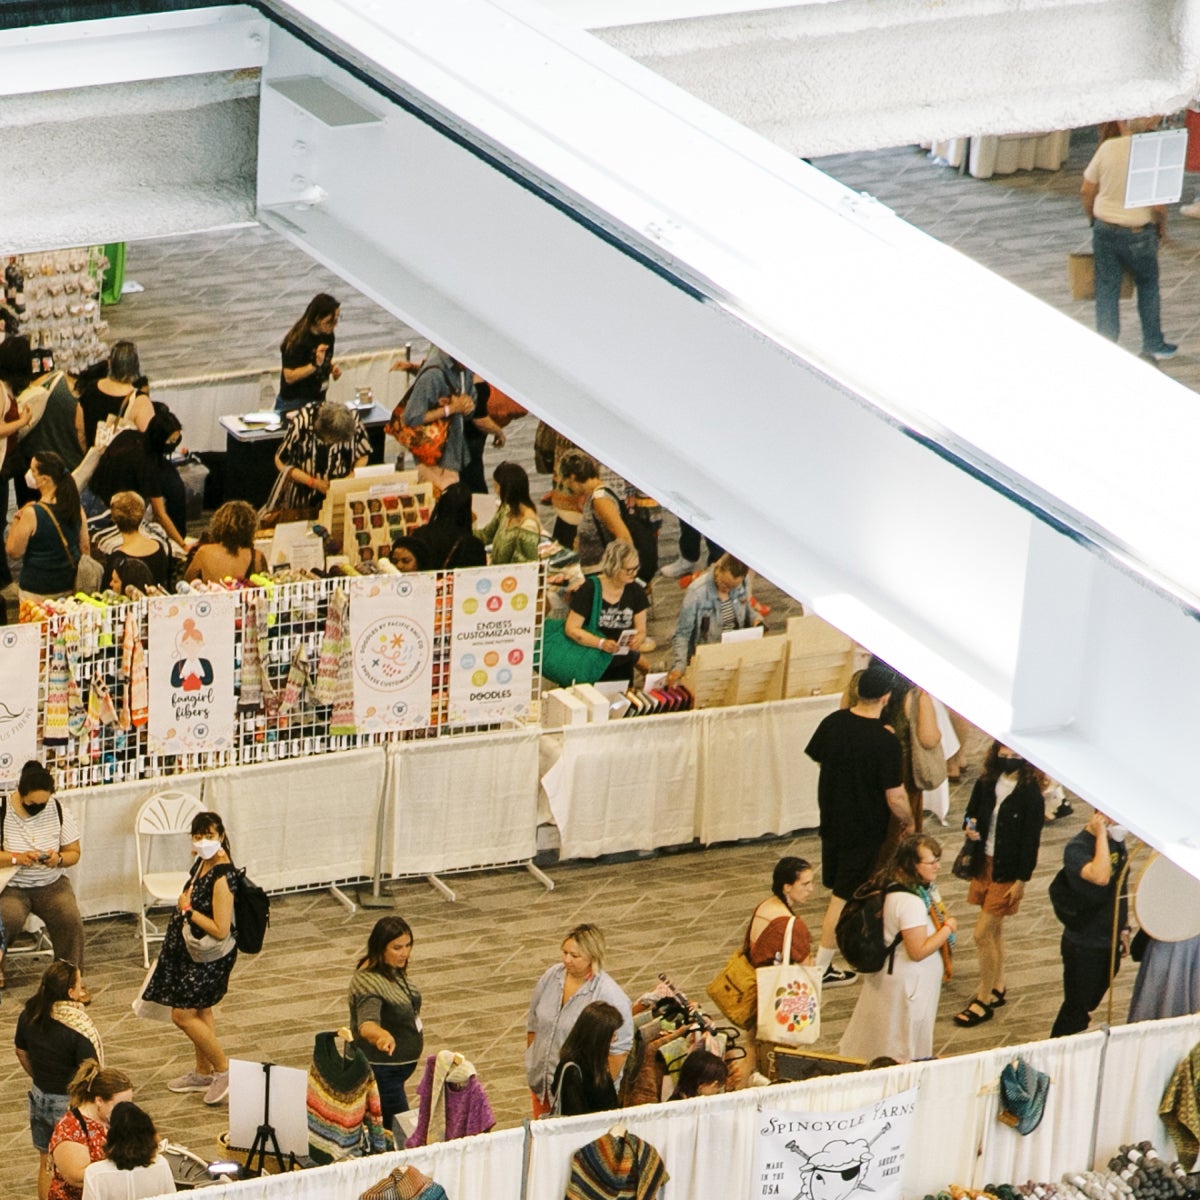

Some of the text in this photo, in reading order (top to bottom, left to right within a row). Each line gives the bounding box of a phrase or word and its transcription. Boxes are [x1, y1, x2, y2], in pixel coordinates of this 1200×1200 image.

[476, 620, 513, 631] ENDLESS
[457, 627, 531, 641] CUSTOMIZATION
[171, 687, 215, 708] fangirl
[470, 689, 512, 701] DOODLES
[175, 704, 210, 721] fibers
[760, 1100, 916, 1136] SPINCYCLE YARNS
[765, 1161, 784, 1170] MADE
[762, 1183, 780, 1195] USA
